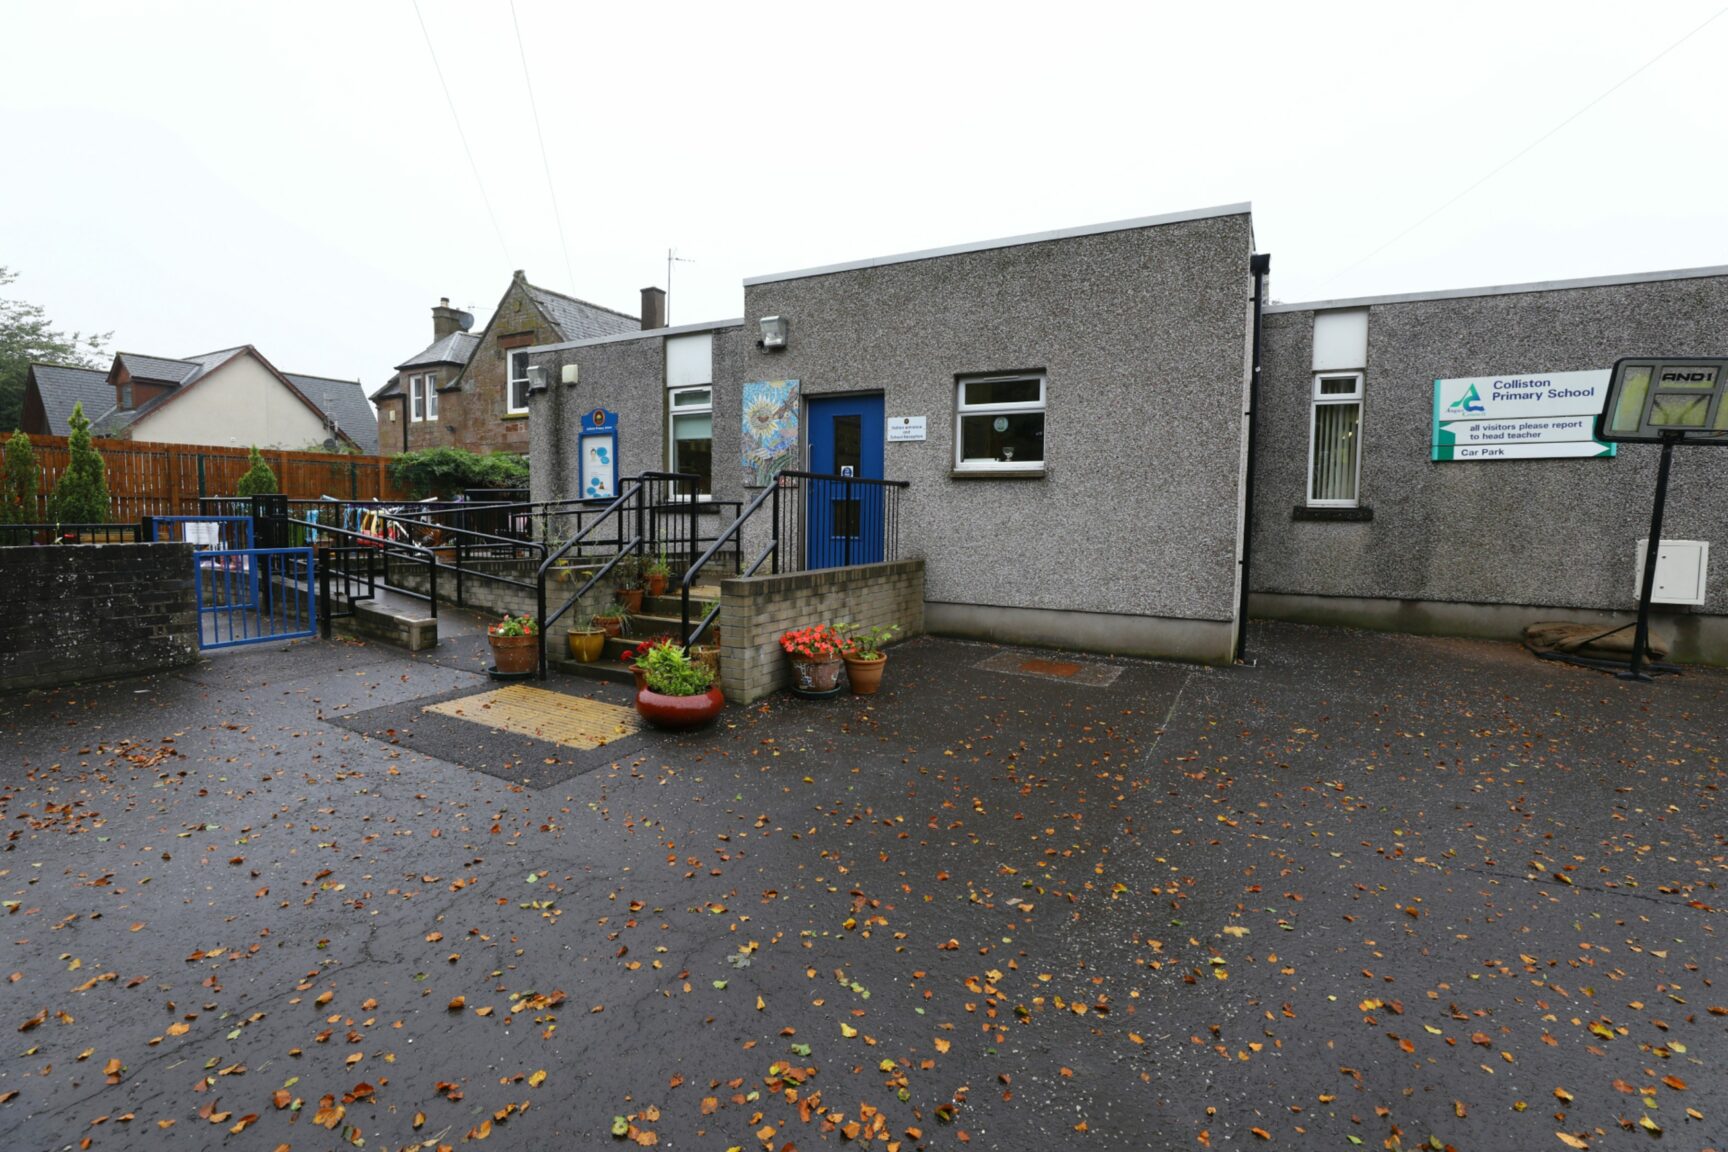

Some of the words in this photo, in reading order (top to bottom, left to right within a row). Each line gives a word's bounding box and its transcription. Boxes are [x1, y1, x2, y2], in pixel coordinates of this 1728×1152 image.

[1493, 379, 1551, 390] Colliston
[1492, 391, 1543, 401] Primary
[1547, 386, 1594, 398] School
[1470, 424, 1480, 432] all
[1482, 423, 1516, 431] visitors
[1518, 422, 1549, 431] please
[1551, 421, 1582, 430] report
[1482, 432, 1504, 440] head
[1507, 431, 1541, 440] teacher
[1461, 448, 1479, 457] Car
[1481, 448, 1504, 456] Park
